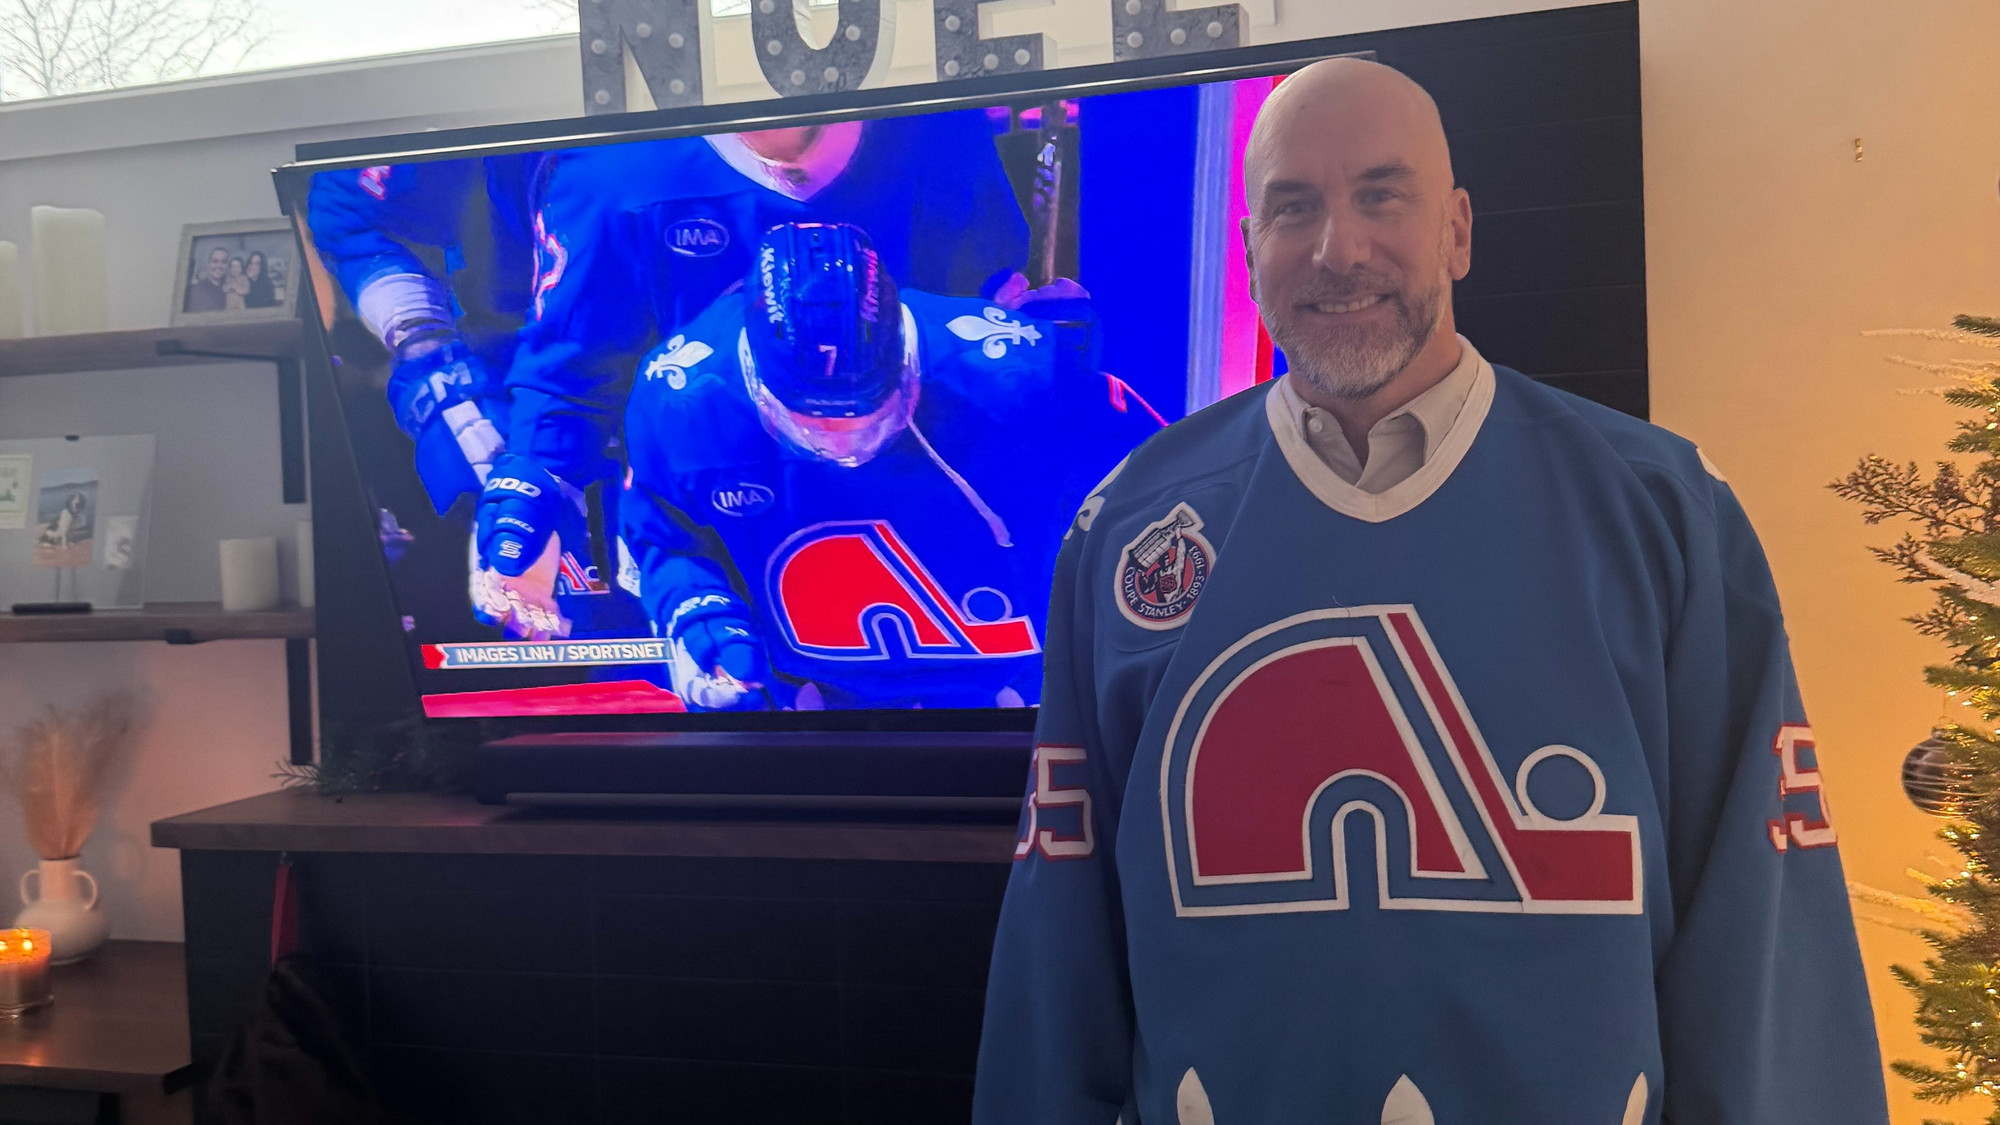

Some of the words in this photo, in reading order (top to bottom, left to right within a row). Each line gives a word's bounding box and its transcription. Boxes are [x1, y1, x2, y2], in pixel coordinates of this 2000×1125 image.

[674, 228, 721, 246] IMA
[818, 344, 837, 377] 7
[718, 489, 766, 508] IMA
[1124, 566, 1139, 606] COUPE
[1138, 602, 1183, 617] STANLEY
[456, 646, 519, 664] IMAGES
[519, 645, 555, 662] LNH
[566, 643, 665, 661] SPORTSNET
